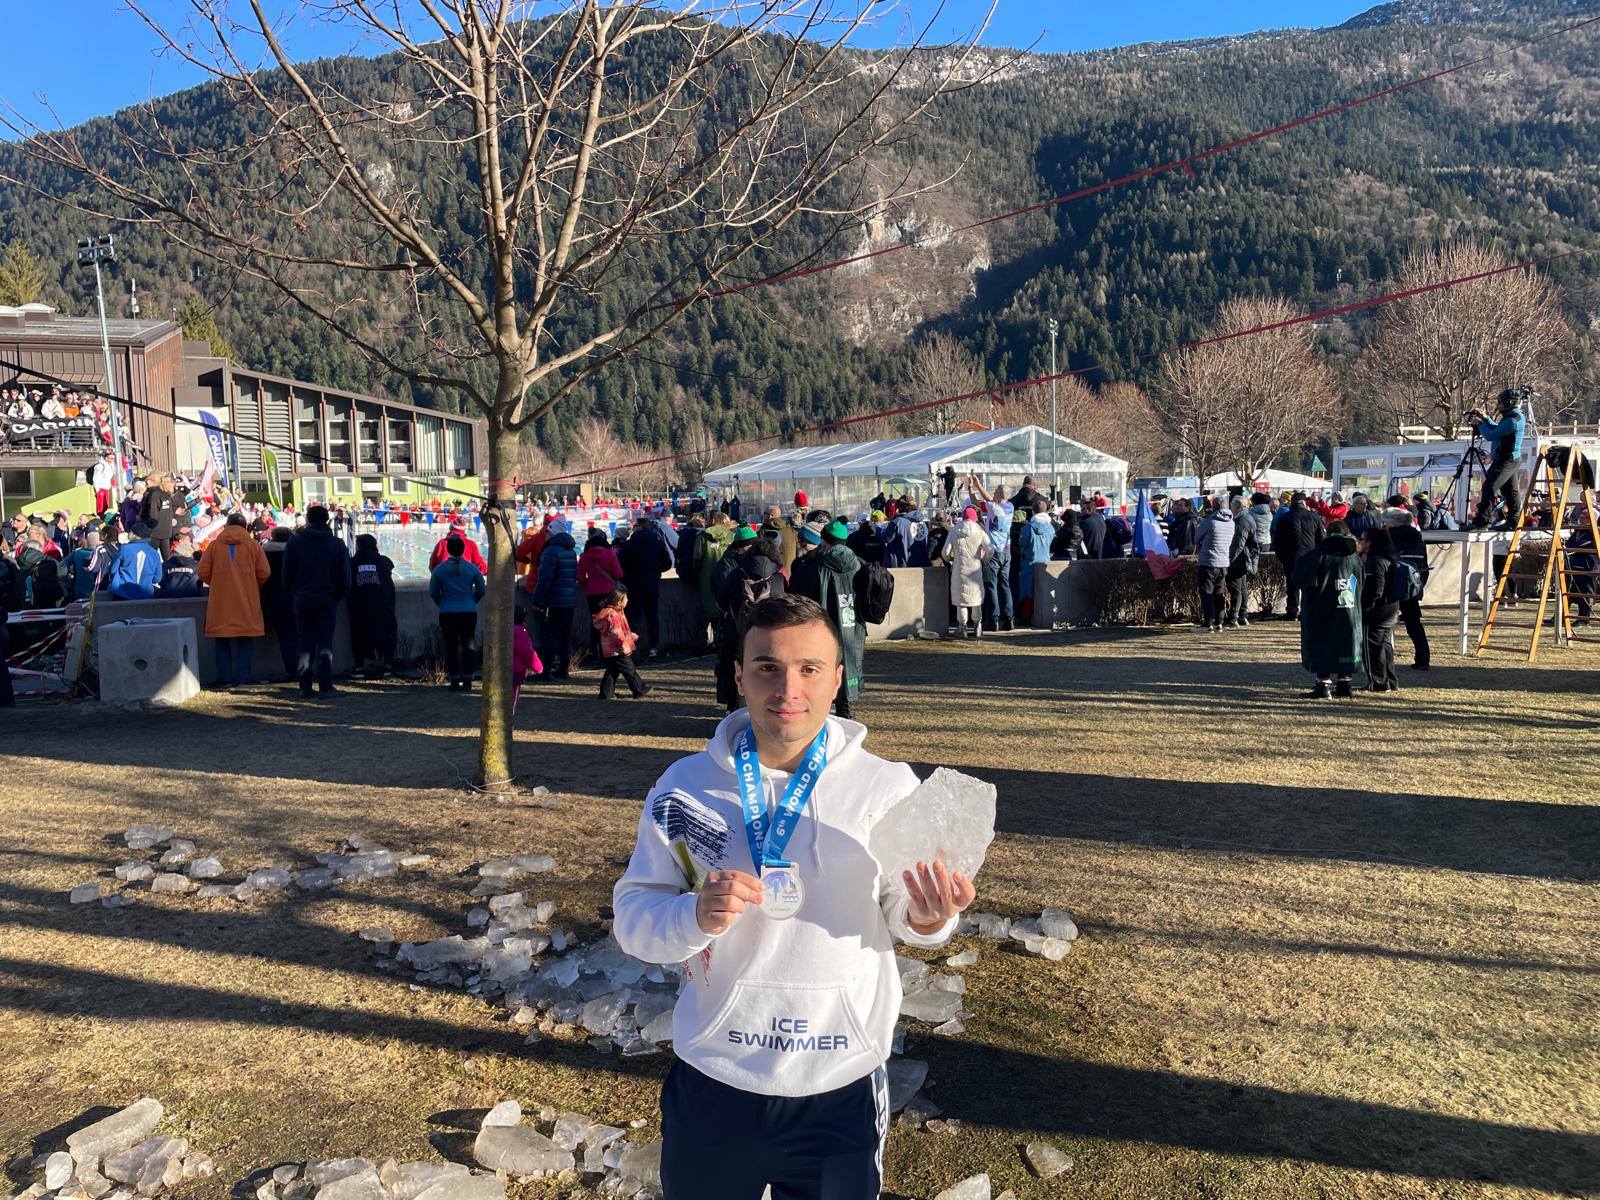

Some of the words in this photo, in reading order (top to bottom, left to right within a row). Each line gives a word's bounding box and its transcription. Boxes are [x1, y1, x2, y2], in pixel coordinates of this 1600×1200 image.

[358, 514, 400, 523] GAMIN
[776, 819, 787, 836] 6th
[783, 773, 811, 817] WORLD
[771, 1017, 808, 1033] ICE
[728, 1030, 848, 1052] SWIMMER
